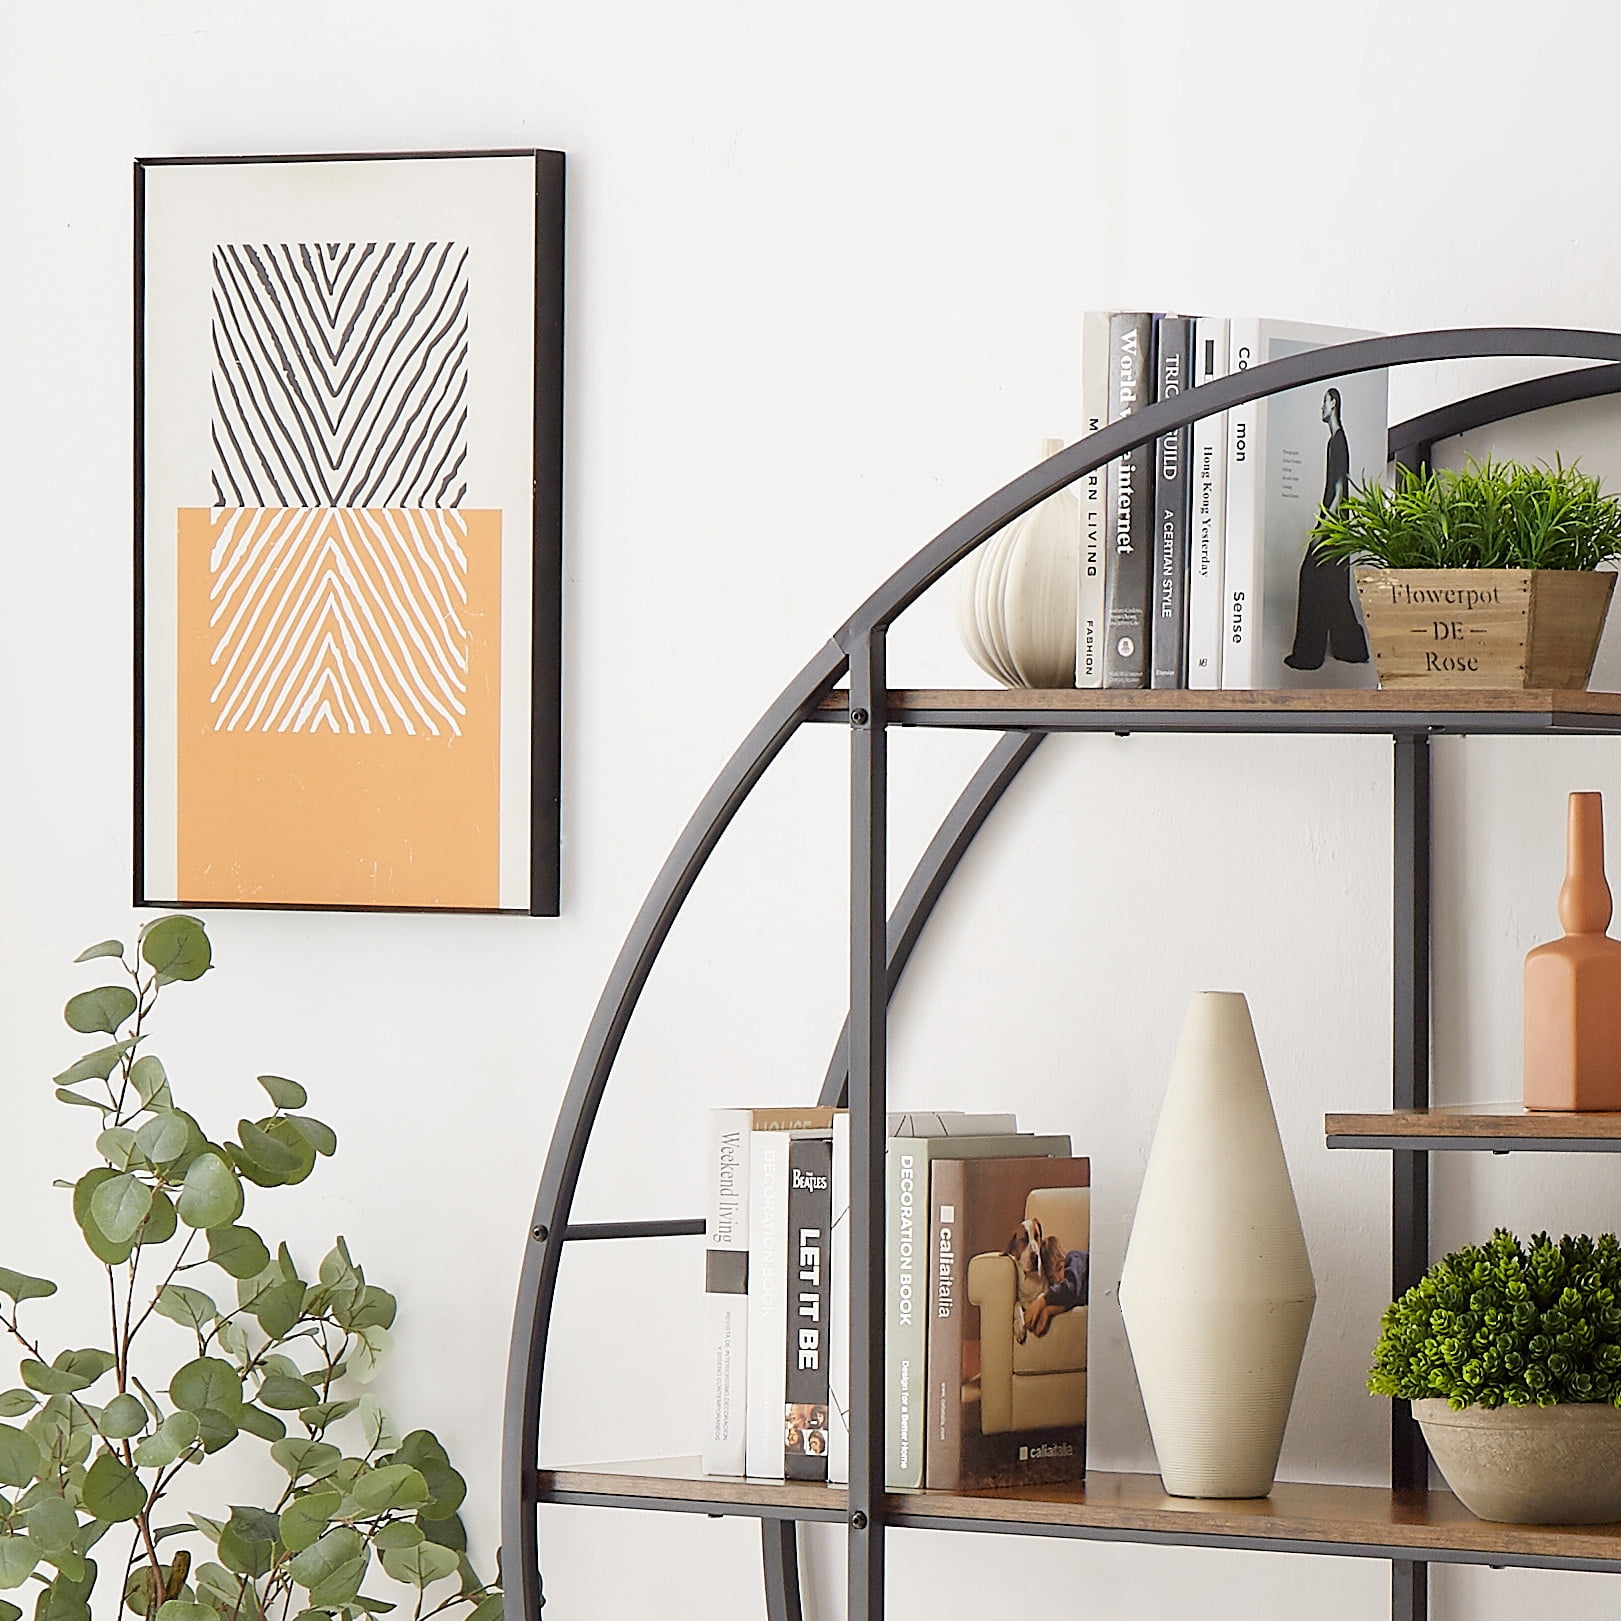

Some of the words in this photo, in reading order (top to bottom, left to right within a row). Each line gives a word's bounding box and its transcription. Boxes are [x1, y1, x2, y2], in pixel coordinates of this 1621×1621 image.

[1118, 328, 1139, 402] World
[1201, 446, 1212, 479] Hong
[1116, 464, 1136, 554] internet
[1164, 509, 1175, 520] A
[1200, 482, 1212, 515] Kong
[1087, 512, 1098, 577] LIVING
[1163, 521, 1175, 577] CERTIAN
[1198, 517, 1211, 578] Yesterday
[1161, 578, 1173, 618] STYLE
[1232, 591, 1245, 644] Sense
[1391, 584, 1501, 609] Flowerpot
[1084, 620, 1094, 675] FASHION
[1433, 621, 1465, 641] DE
[1426, 652, 1479, 672] Rose
[720, 1132, 740, 1197] Weekend
[713, 1202, 739, 1243] living
[900, 1155, 914, 1270] DECORATION
[799, 1228, 821, 1286] LET
[938, 1227, 954, 1319] caliaitalia
[799, 1293, 821, 1322] IT
[899, 1273, 912, 1326] BOOK
[798, 1328, 820, 1370] BE
[901, 1360, 910, 1390] Design
[901, 1392, 910, 1405] for
